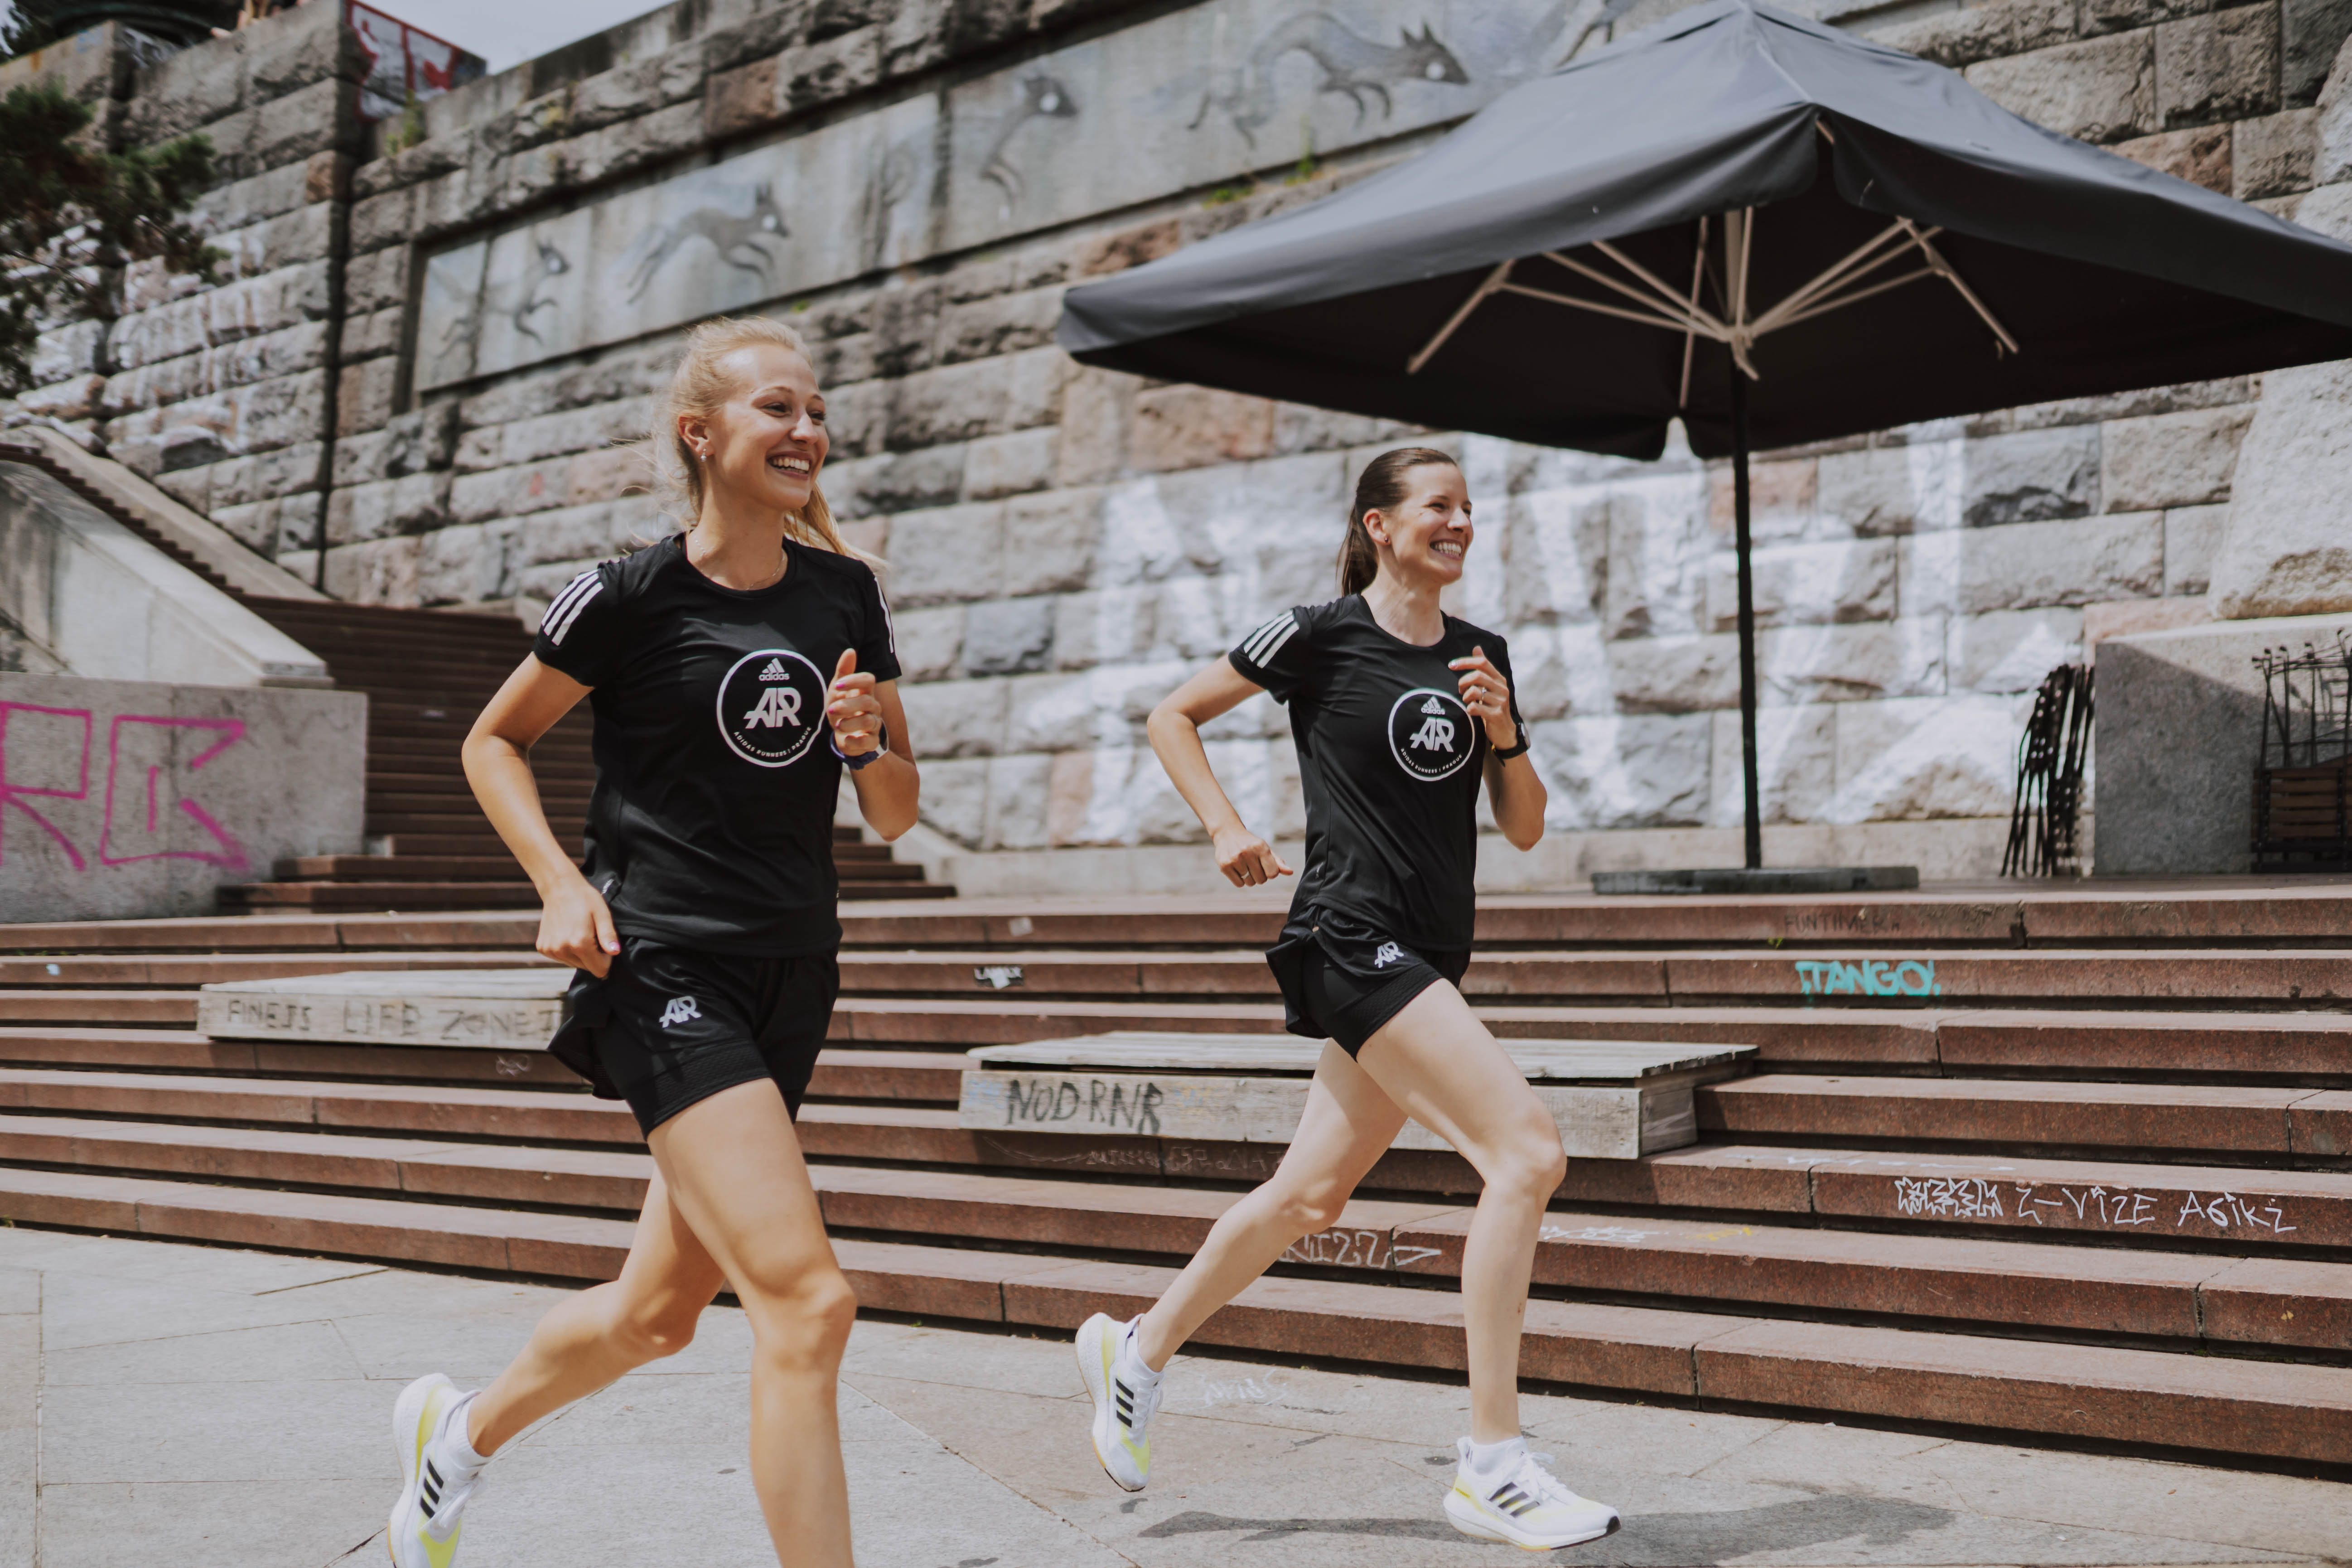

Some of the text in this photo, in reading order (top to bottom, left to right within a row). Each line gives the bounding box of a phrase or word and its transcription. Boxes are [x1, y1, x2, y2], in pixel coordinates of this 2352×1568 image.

[759, 672, 790, 681] adidas
[743, 687, 801, 729] AR
[1421, 707, 1445, 715] adidas
[734, 726, 812, 757] ADIDAS RUNNERS PRAGUE
[1409, 716, 1454, 753] AR
[1401, 748, 1463, 774] ADIDAS RUNNERS PRAGUE
[1374, 941, 1404, 968] AR
[659, 996, 702, 1028] AR
